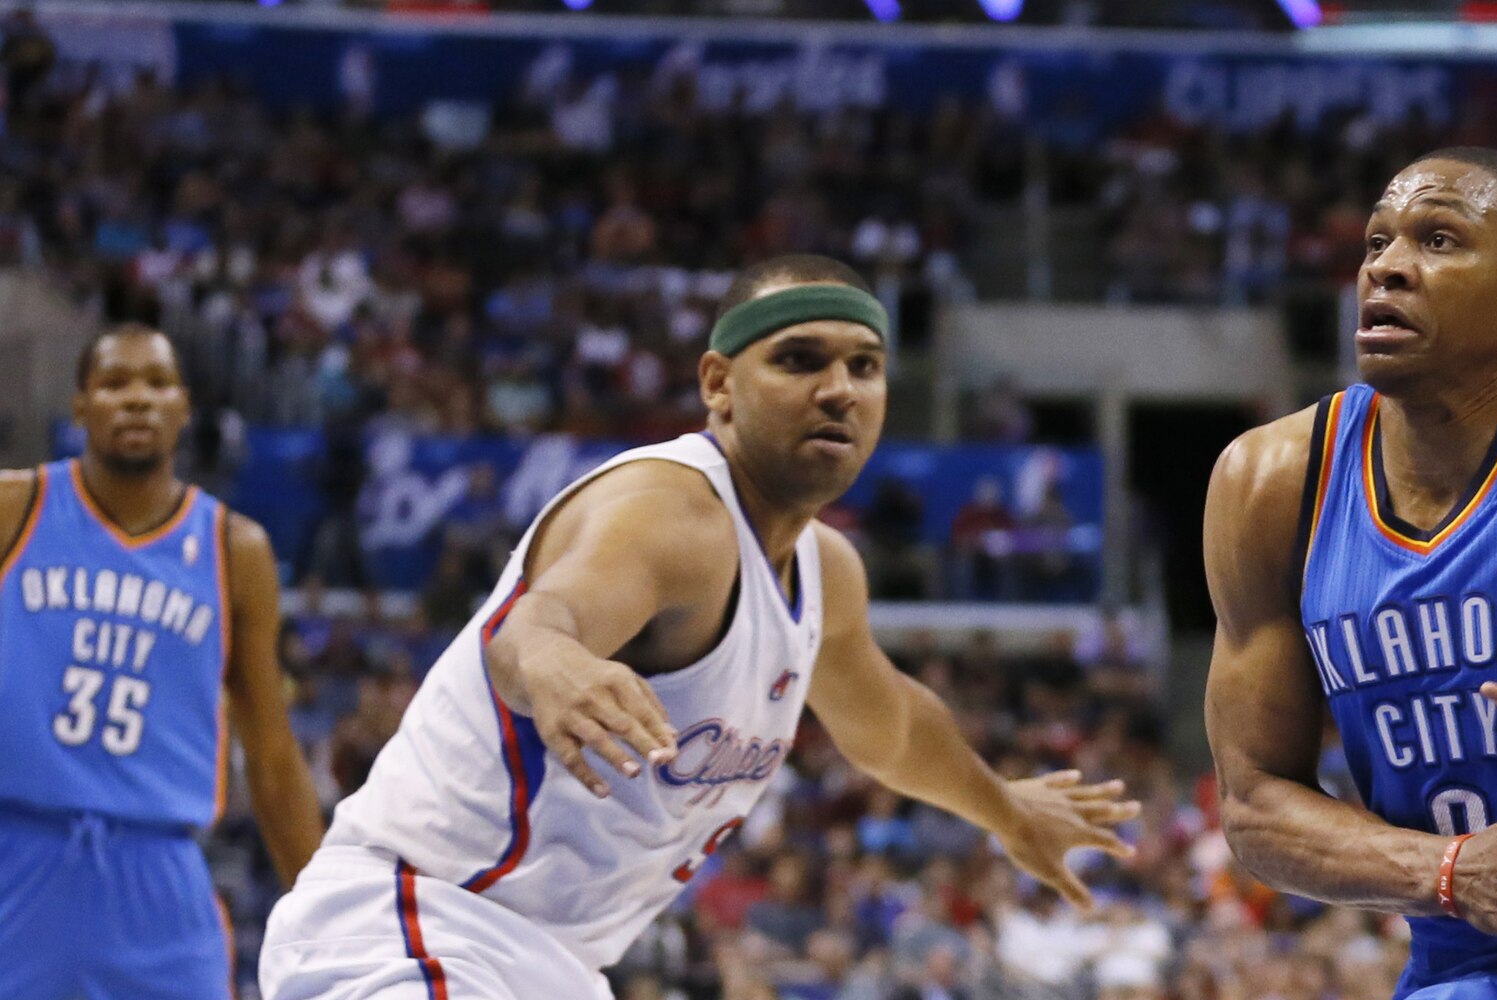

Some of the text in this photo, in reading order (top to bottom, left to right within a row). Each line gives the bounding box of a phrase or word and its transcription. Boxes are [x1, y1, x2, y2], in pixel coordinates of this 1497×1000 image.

[22, 567, 213, 644] OKLAHOMA
[73, 617, 155, 672] CITY
[54, 666, 150, 757] 35
[1375, 692, 1497, 768] CITY
